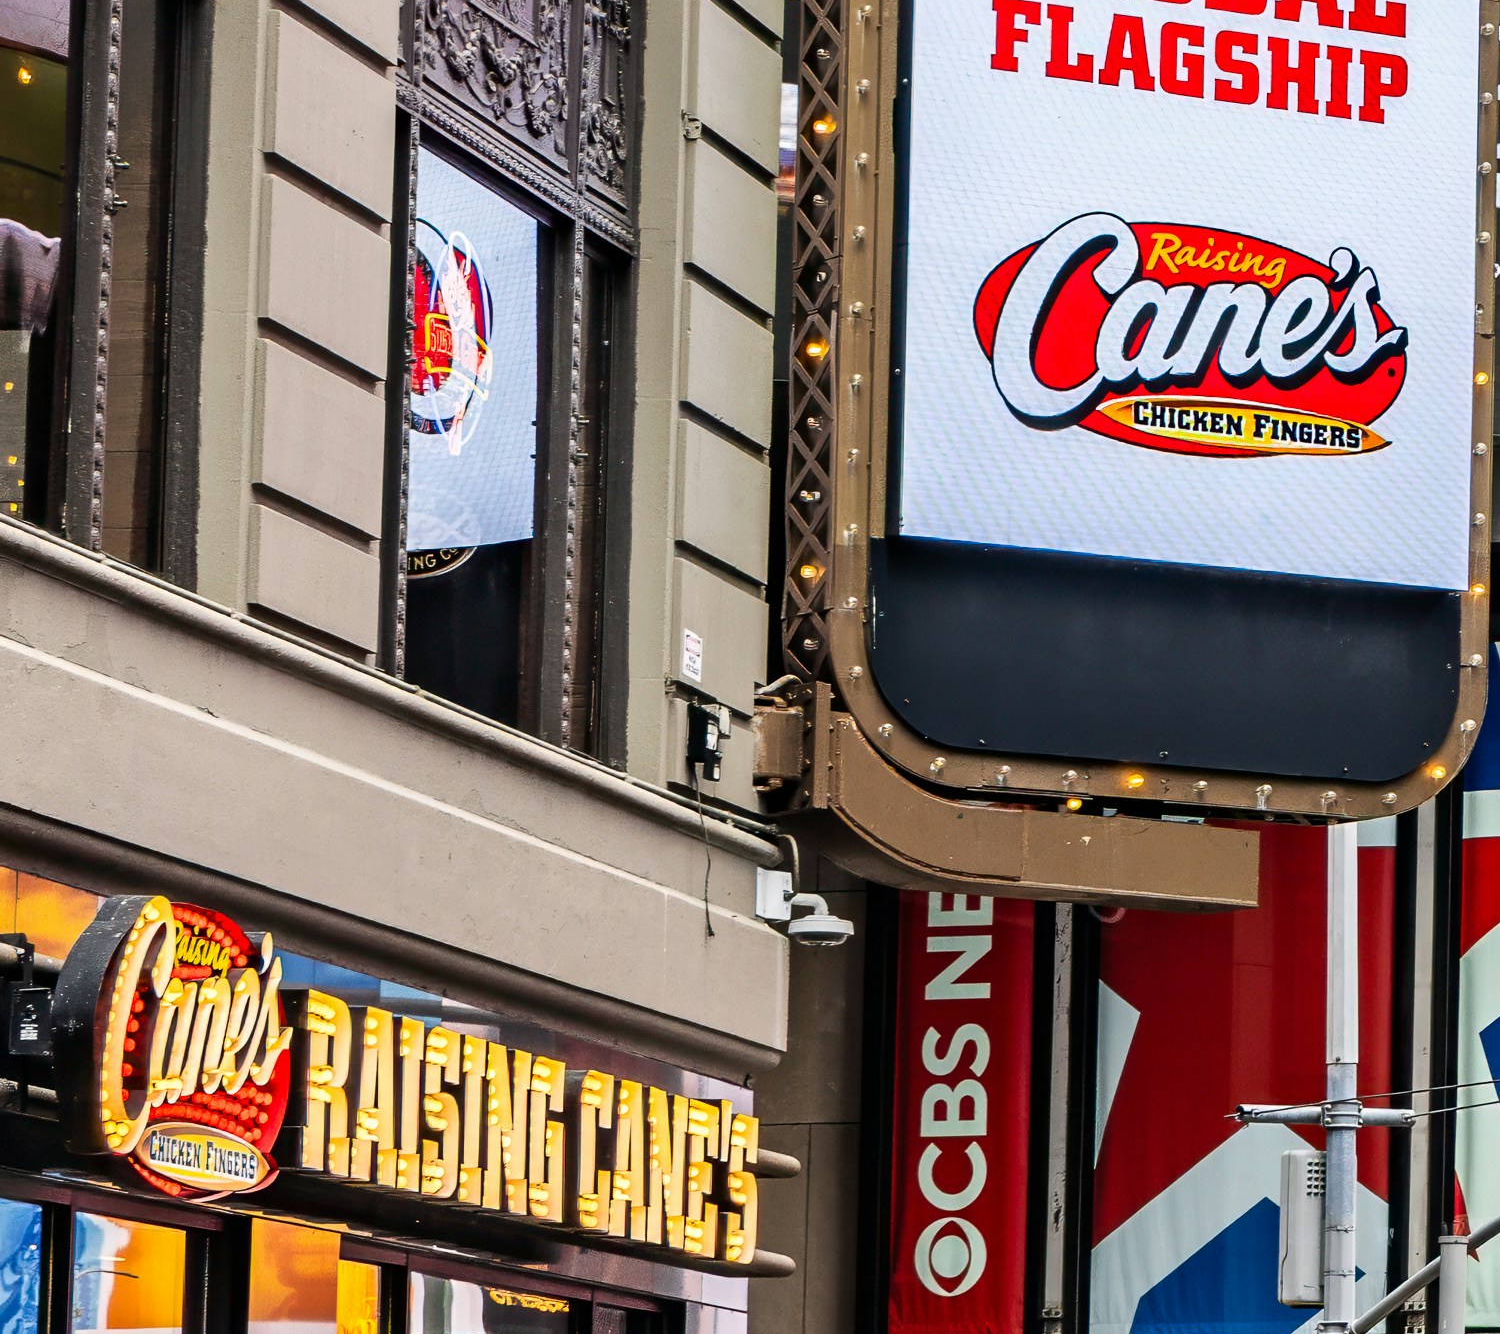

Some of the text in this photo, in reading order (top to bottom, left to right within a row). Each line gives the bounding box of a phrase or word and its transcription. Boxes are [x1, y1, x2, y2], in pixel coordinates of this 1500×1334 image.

[992, 212, 1408, 430] Cane's
[1146, 233, 1286, 289] Raising
[1133, 402, 1361, 450] CHICKEN FINGERS
[172, 921, 231, 974] Raising
[100, 895, 292, 1154] Cane's
[149, 1128, 259, 1180] CHICKEN FINGERS
[303, 989, 759, 1264] RAISING CANE'S
[918, 1023, 990, 1211] CBS
